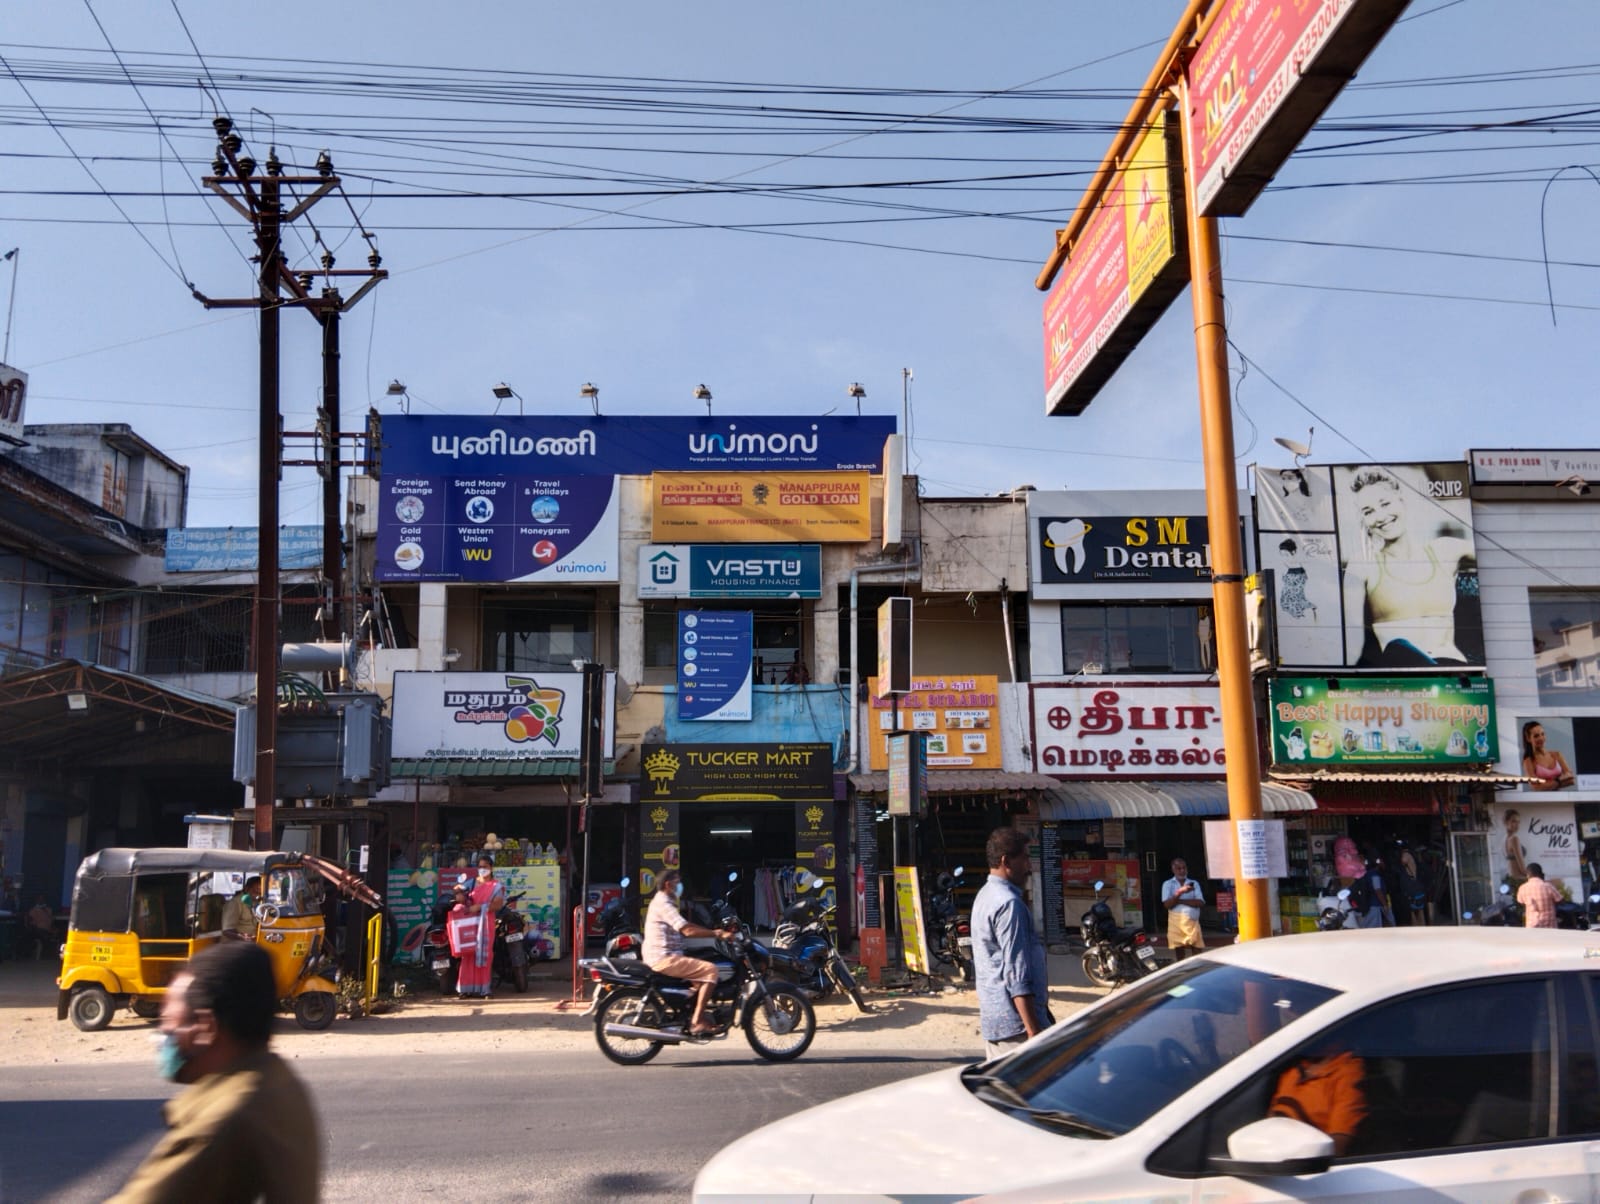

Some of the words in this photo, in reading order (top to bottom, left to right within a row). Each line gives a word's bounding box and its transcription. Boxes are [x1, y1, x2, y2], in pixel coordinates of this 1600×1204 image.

[689, 424, 818, 454] unimoni
[431, 429, 596, 459] யுனிமணி
[395, 479, 429, 488] Foreign
[455, 480, 477, 488] Send
[478, 480, 506, 489] Money
[534, 480, 560, 488] Travel
[779, 483, 860, 492] MANAPPURAM
[391, 487, 433, 495] Exchange
[464, 487, 496, 495] Abroad
[532, 487, 569, 496] Holidays
[781, 494, 819, 504] GOLD
[822, 494, 859, 504] LOAN
[400, 527, 422, 535] Gold
[458, 527, 494, 535] Western
[520, 527, 570, 536] Moneygram
[400, 535, 422, 543] Loan
[463, 535, 488, 543] Union
[461, 549, 492, 561] WU
[1103, 543, 1212, 569] Dental
[556, 561, 607, 574] unimoni
[706, 559, 801, 577] VASTU
[711, 578, 756, 586] HOUSING
[759, 578, 801, 586] FINANCE
[447, 689, 527, 709] மதுரம்
[872, 695, 923, 707] HOEL
[1276, 701, 1329, 722] Best
[1334, 702, 1404, 727] Happy
[1410, 701, 1489, 727] Shoppy
[686, 752, 759, 766] TUCKER
[766, 752, 814, 766] MART
[1528, 817, 1574, 836] Knows
[1548, 834, 1572, 849] Me
